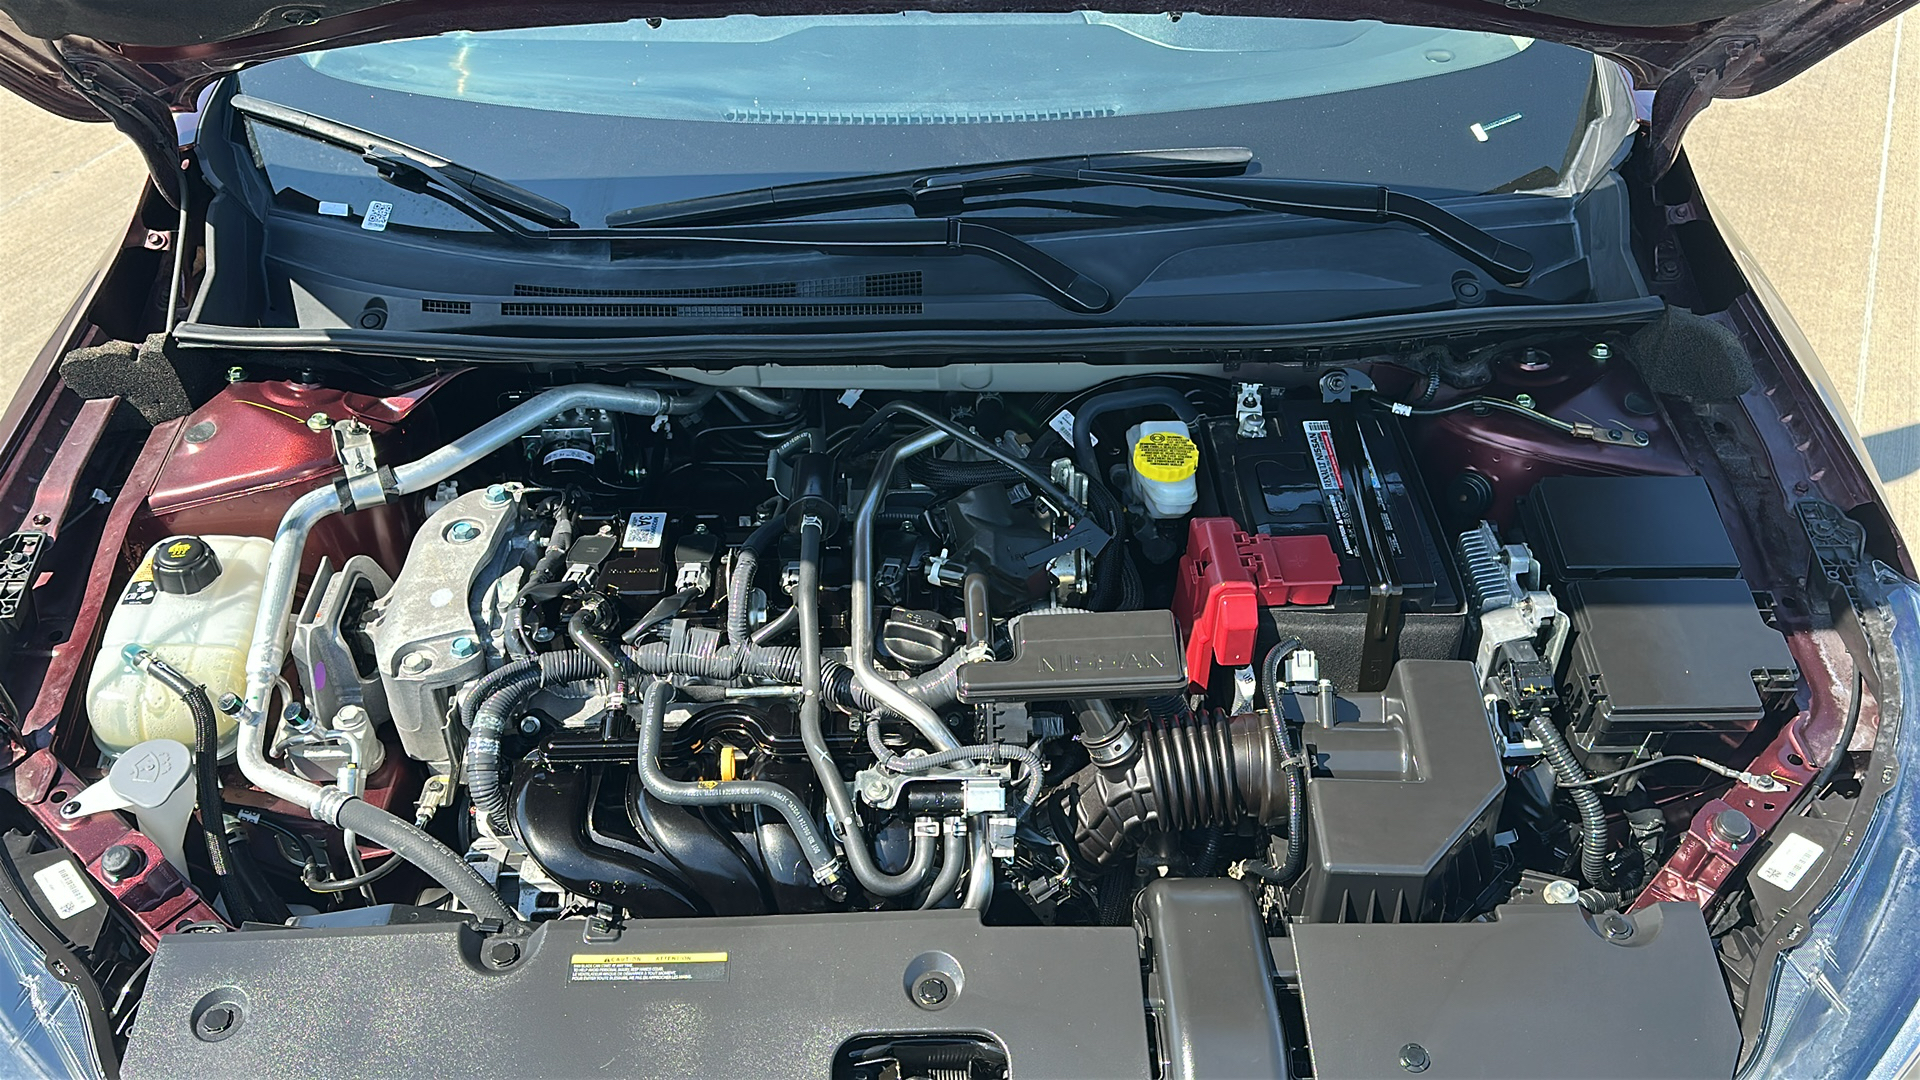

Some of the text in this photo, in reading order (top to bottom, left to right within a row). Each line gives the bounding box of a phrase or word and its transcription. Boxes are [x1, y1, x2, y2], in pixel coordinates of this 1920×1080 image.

[1309, 432, 1324, 461] NISSAN
[637, 516, 652, 527] 3A
[1037, 650, 1170, 673] NISSAN
